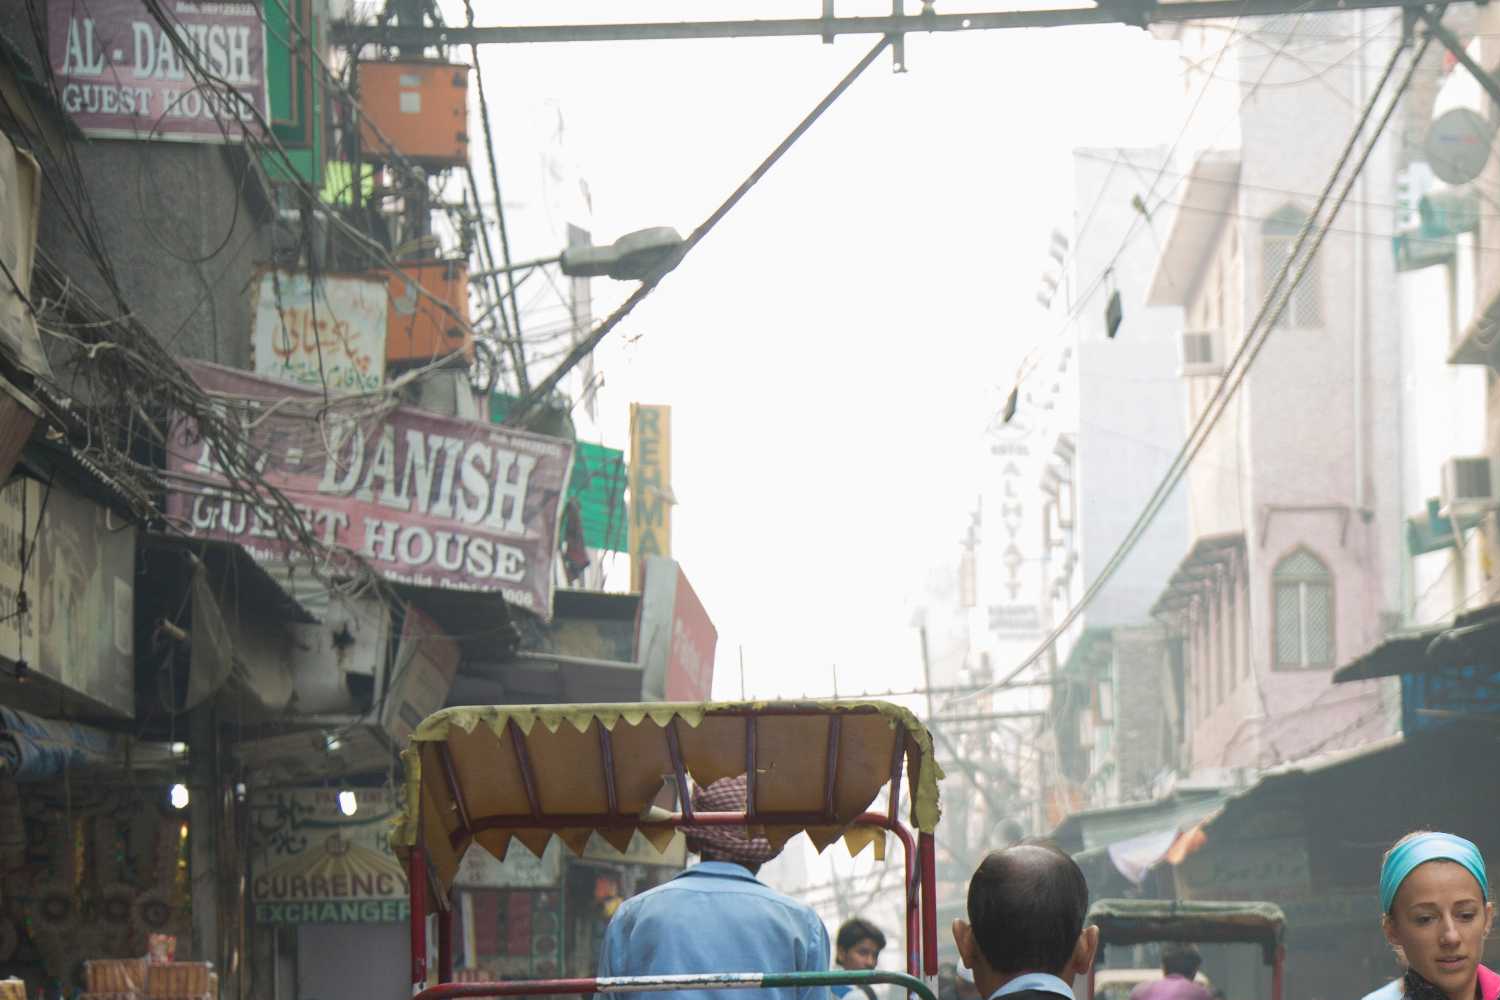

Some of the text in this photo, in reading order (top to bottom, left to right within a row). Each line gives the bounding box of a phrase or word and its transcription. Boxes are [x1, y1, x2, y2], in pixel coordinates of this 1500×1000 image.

[62, 83, 152, 115] GUEST
[318, 413, 536, 536] DANISH
[361, 515, 528, 584] HOUSE
